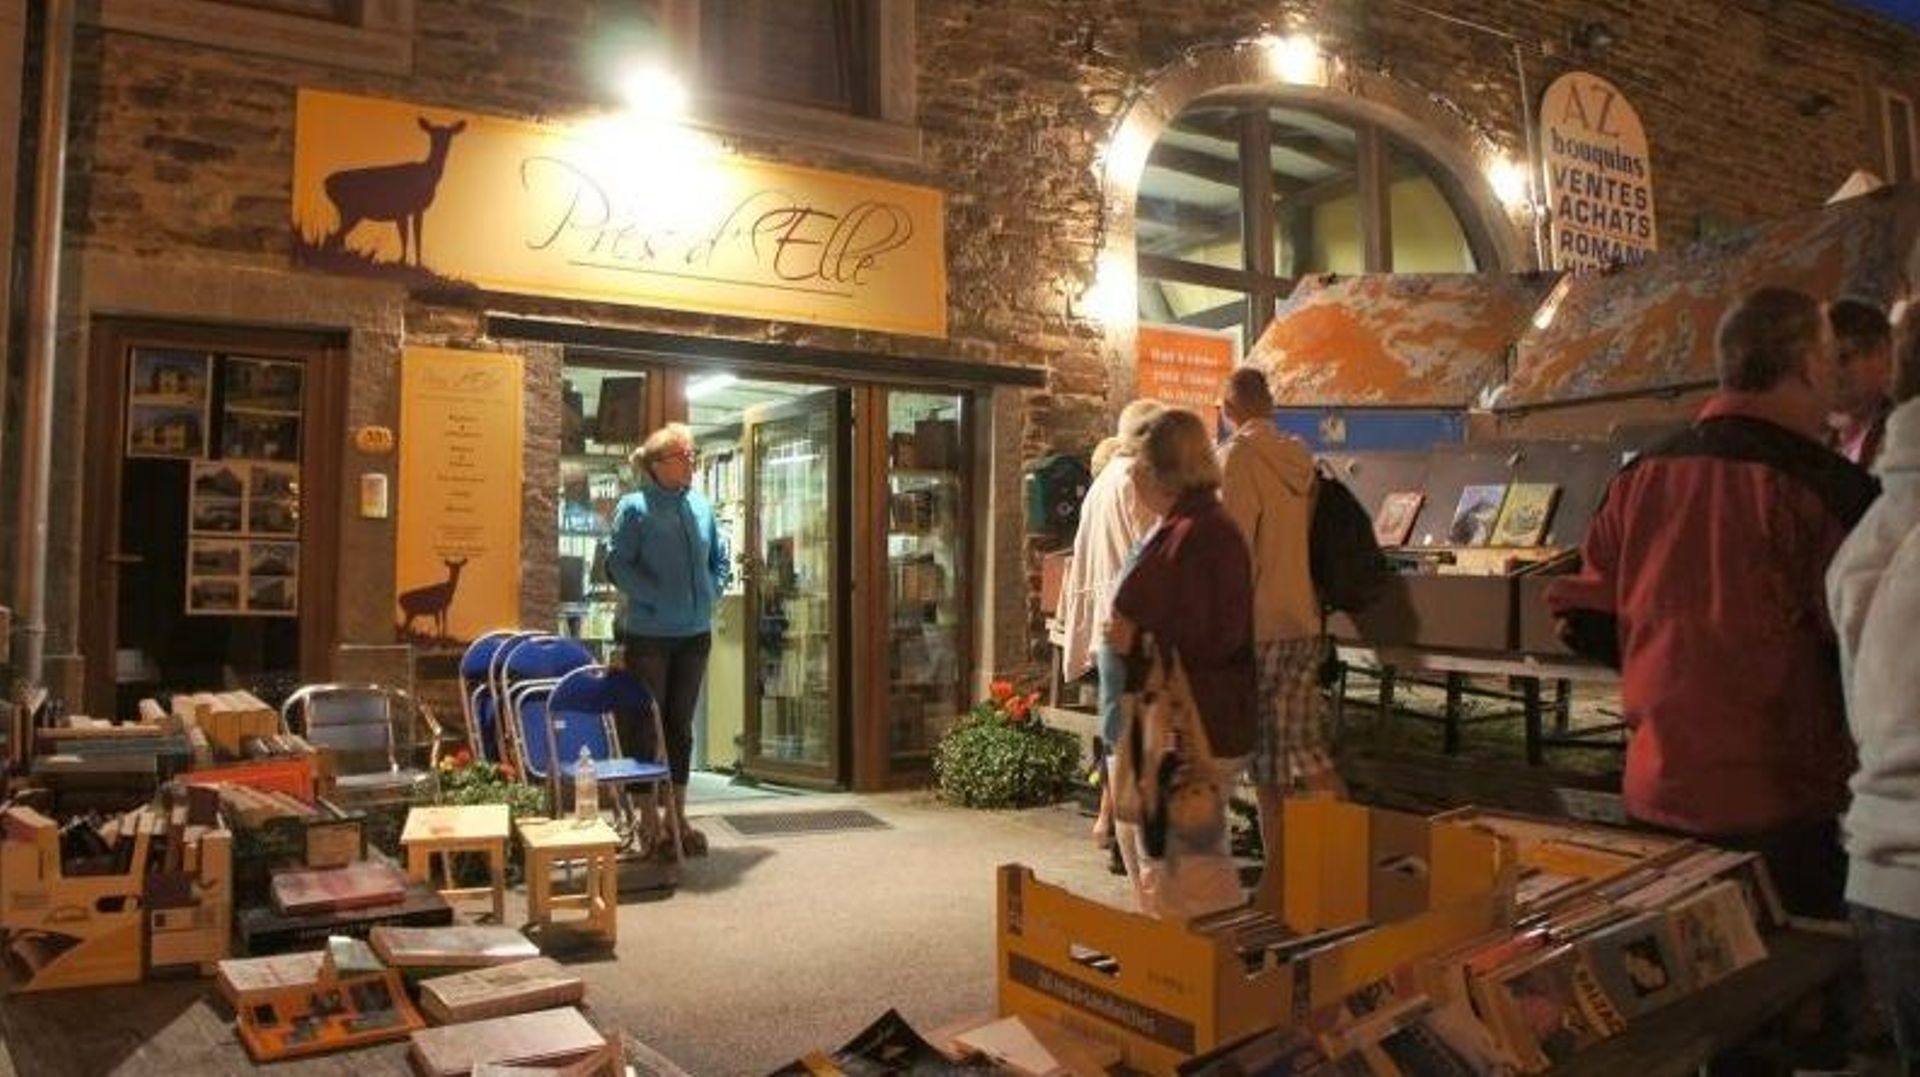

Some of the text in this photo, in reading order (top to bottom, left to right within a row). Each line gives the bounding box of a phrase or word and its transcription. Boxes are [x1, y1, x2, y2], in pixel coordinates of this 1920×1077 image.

[1561, 79, 1620, 138] AZ
[1551, 126, 1645, 179] bouquins
[1552, 164, 1648, 211] VENTES
[1558, 195, 1650, 239] ACHATS
